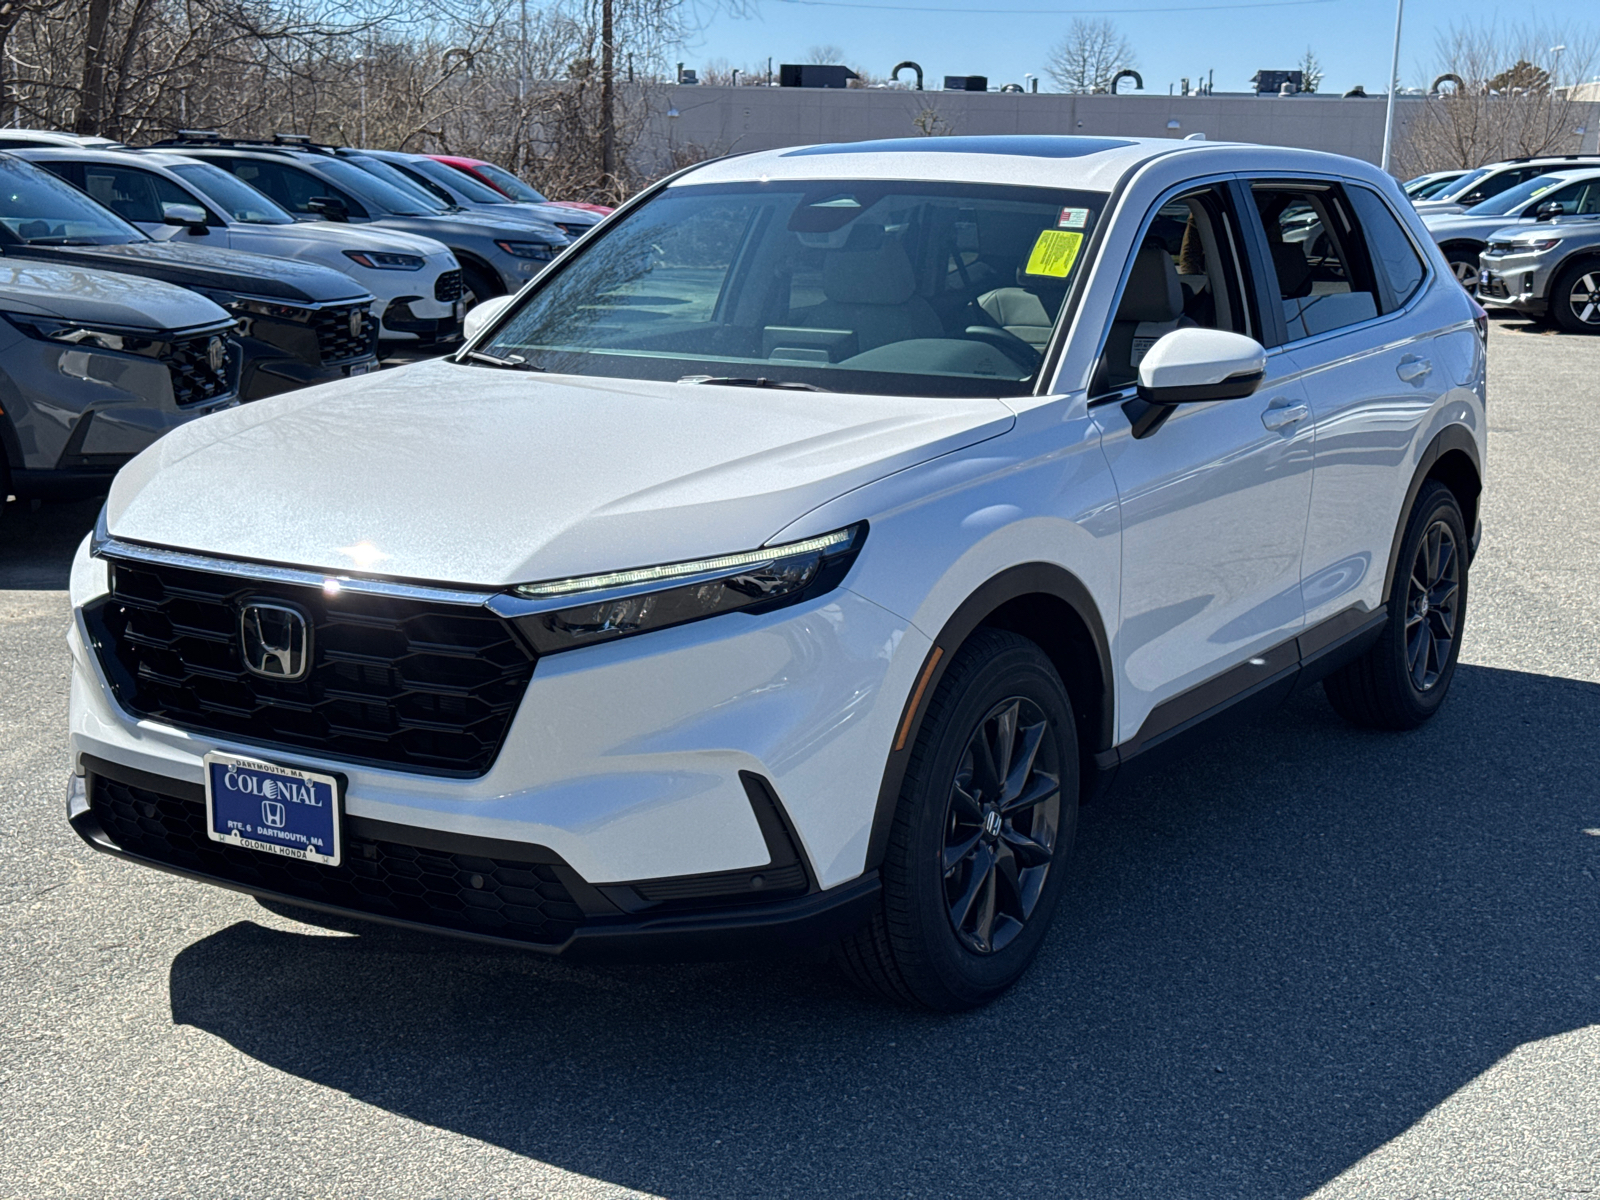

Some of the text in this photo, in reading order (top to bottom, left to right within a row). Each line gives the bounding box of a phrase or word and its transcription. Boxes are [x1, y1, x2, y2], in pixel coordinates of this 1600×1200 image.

[224, 772, 322, 807] COLONIAL
[227, 820, 323, 846] RTE. 6 DARTMOUTH, MA
[240, 838, 307, 859] COLONIAL HONDA
